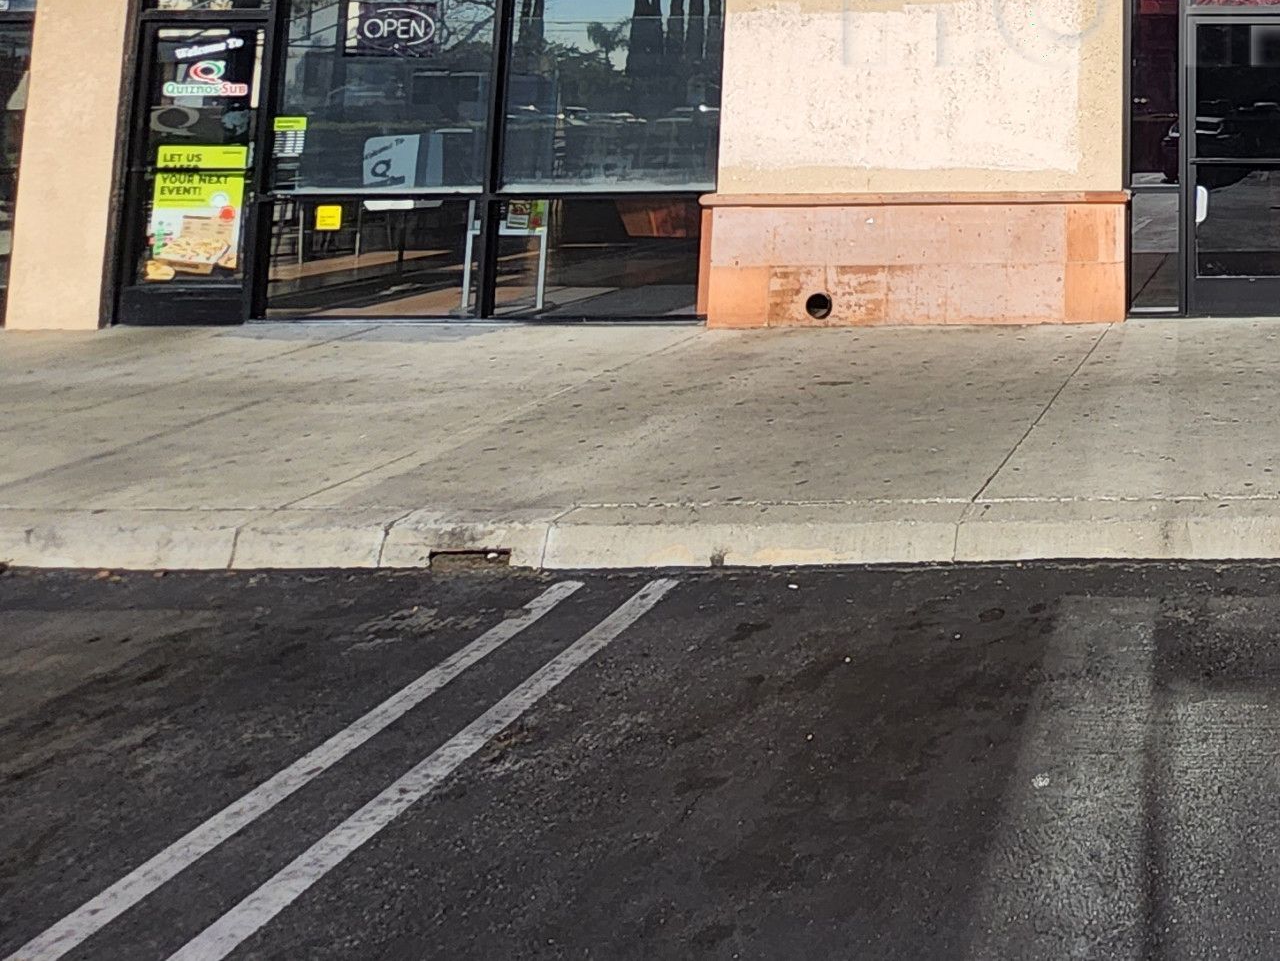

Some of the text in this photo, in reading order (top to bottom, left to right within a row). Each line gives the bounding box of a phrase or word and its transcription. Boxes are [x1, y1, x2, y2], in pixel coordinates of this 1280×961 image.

[363, 18, 425, 38] OPEN
[163, 153, 202, 162] LET US
[161, 173, 229, 184] YOUR NEXT
[160, 186, 202, 195] EVENT!
